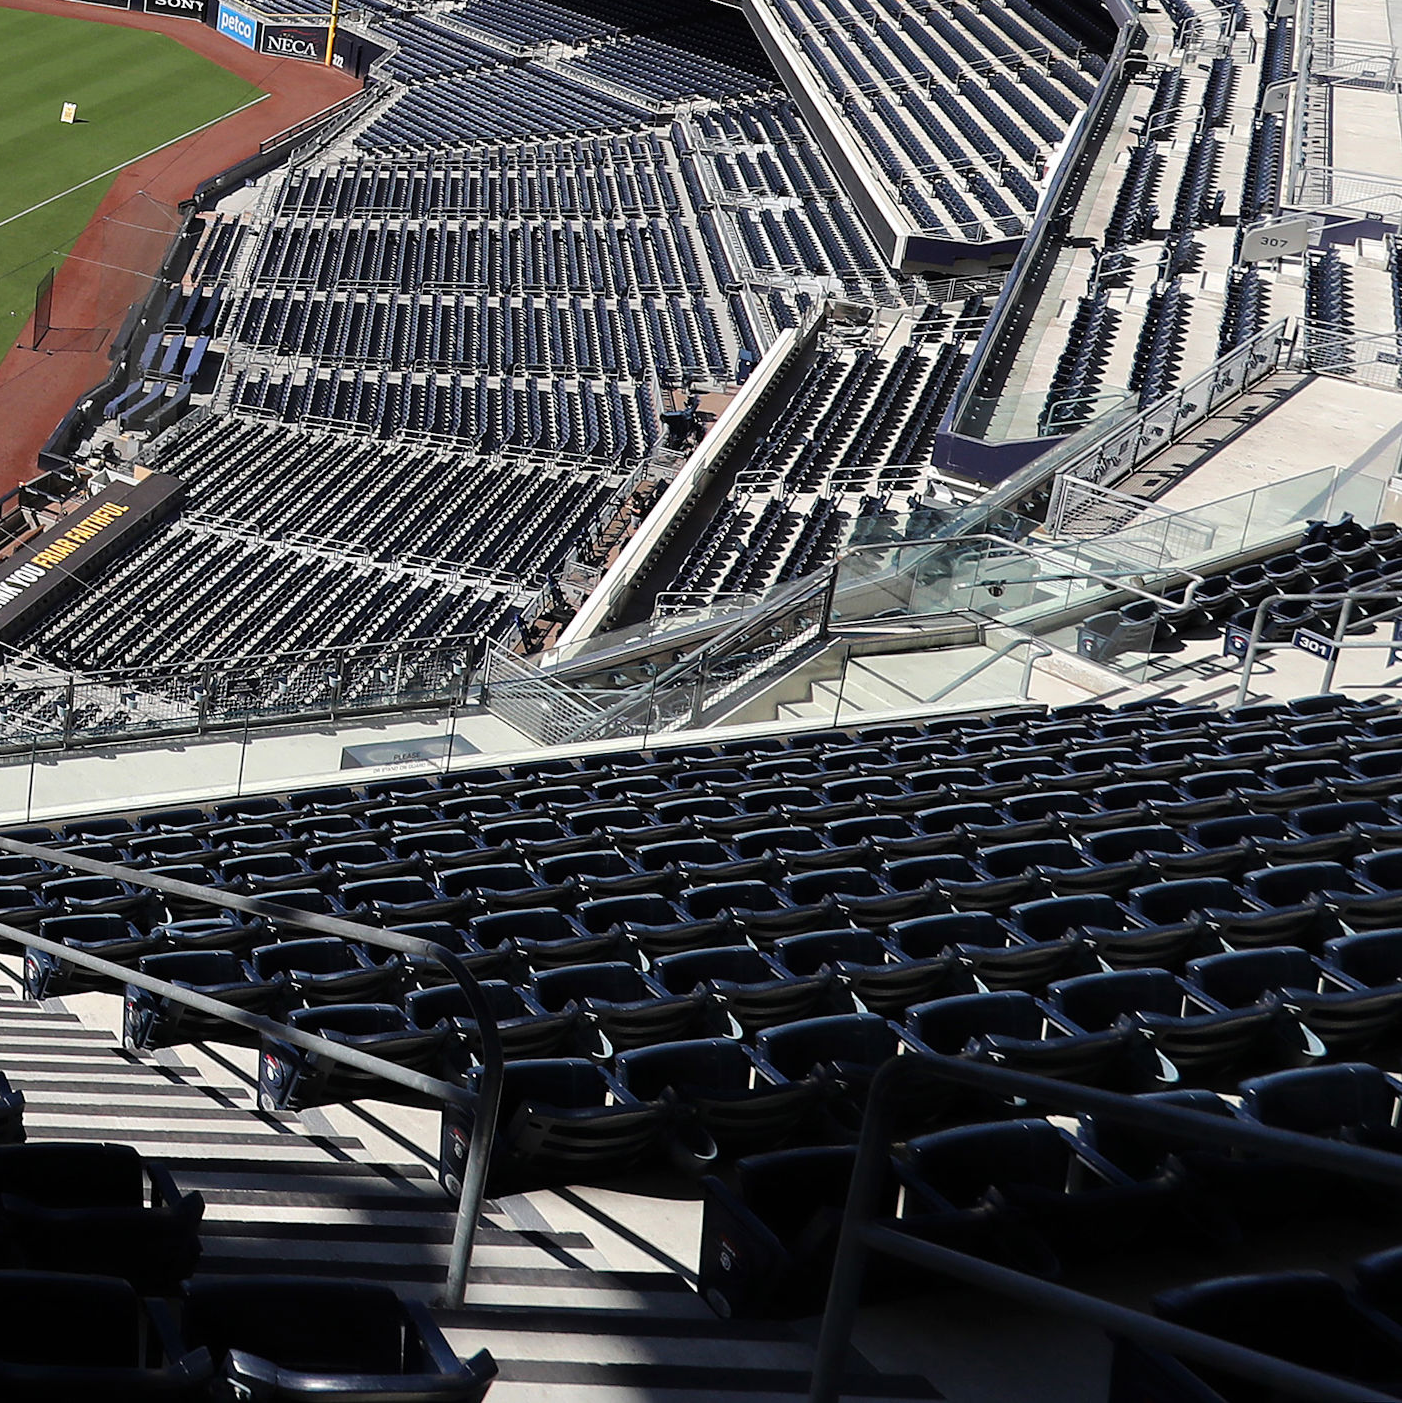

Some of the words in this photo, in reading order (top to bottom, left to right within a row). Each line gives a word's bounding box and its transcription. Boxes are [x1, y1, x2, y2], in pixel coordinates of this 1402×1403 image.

[221, 11, 252, 39] petco
[267, 35, 318, 58] NECA
[1260, 236, 1288, 248] 307
[6, 562, 47, 589] YOU
[31, 537, 81, 570] FRIAR
[64, 501, 131, 545] FAITHFUL
[1298, 636, 1327, 656] 301
[394, 752, 421, 761] PLEASE
